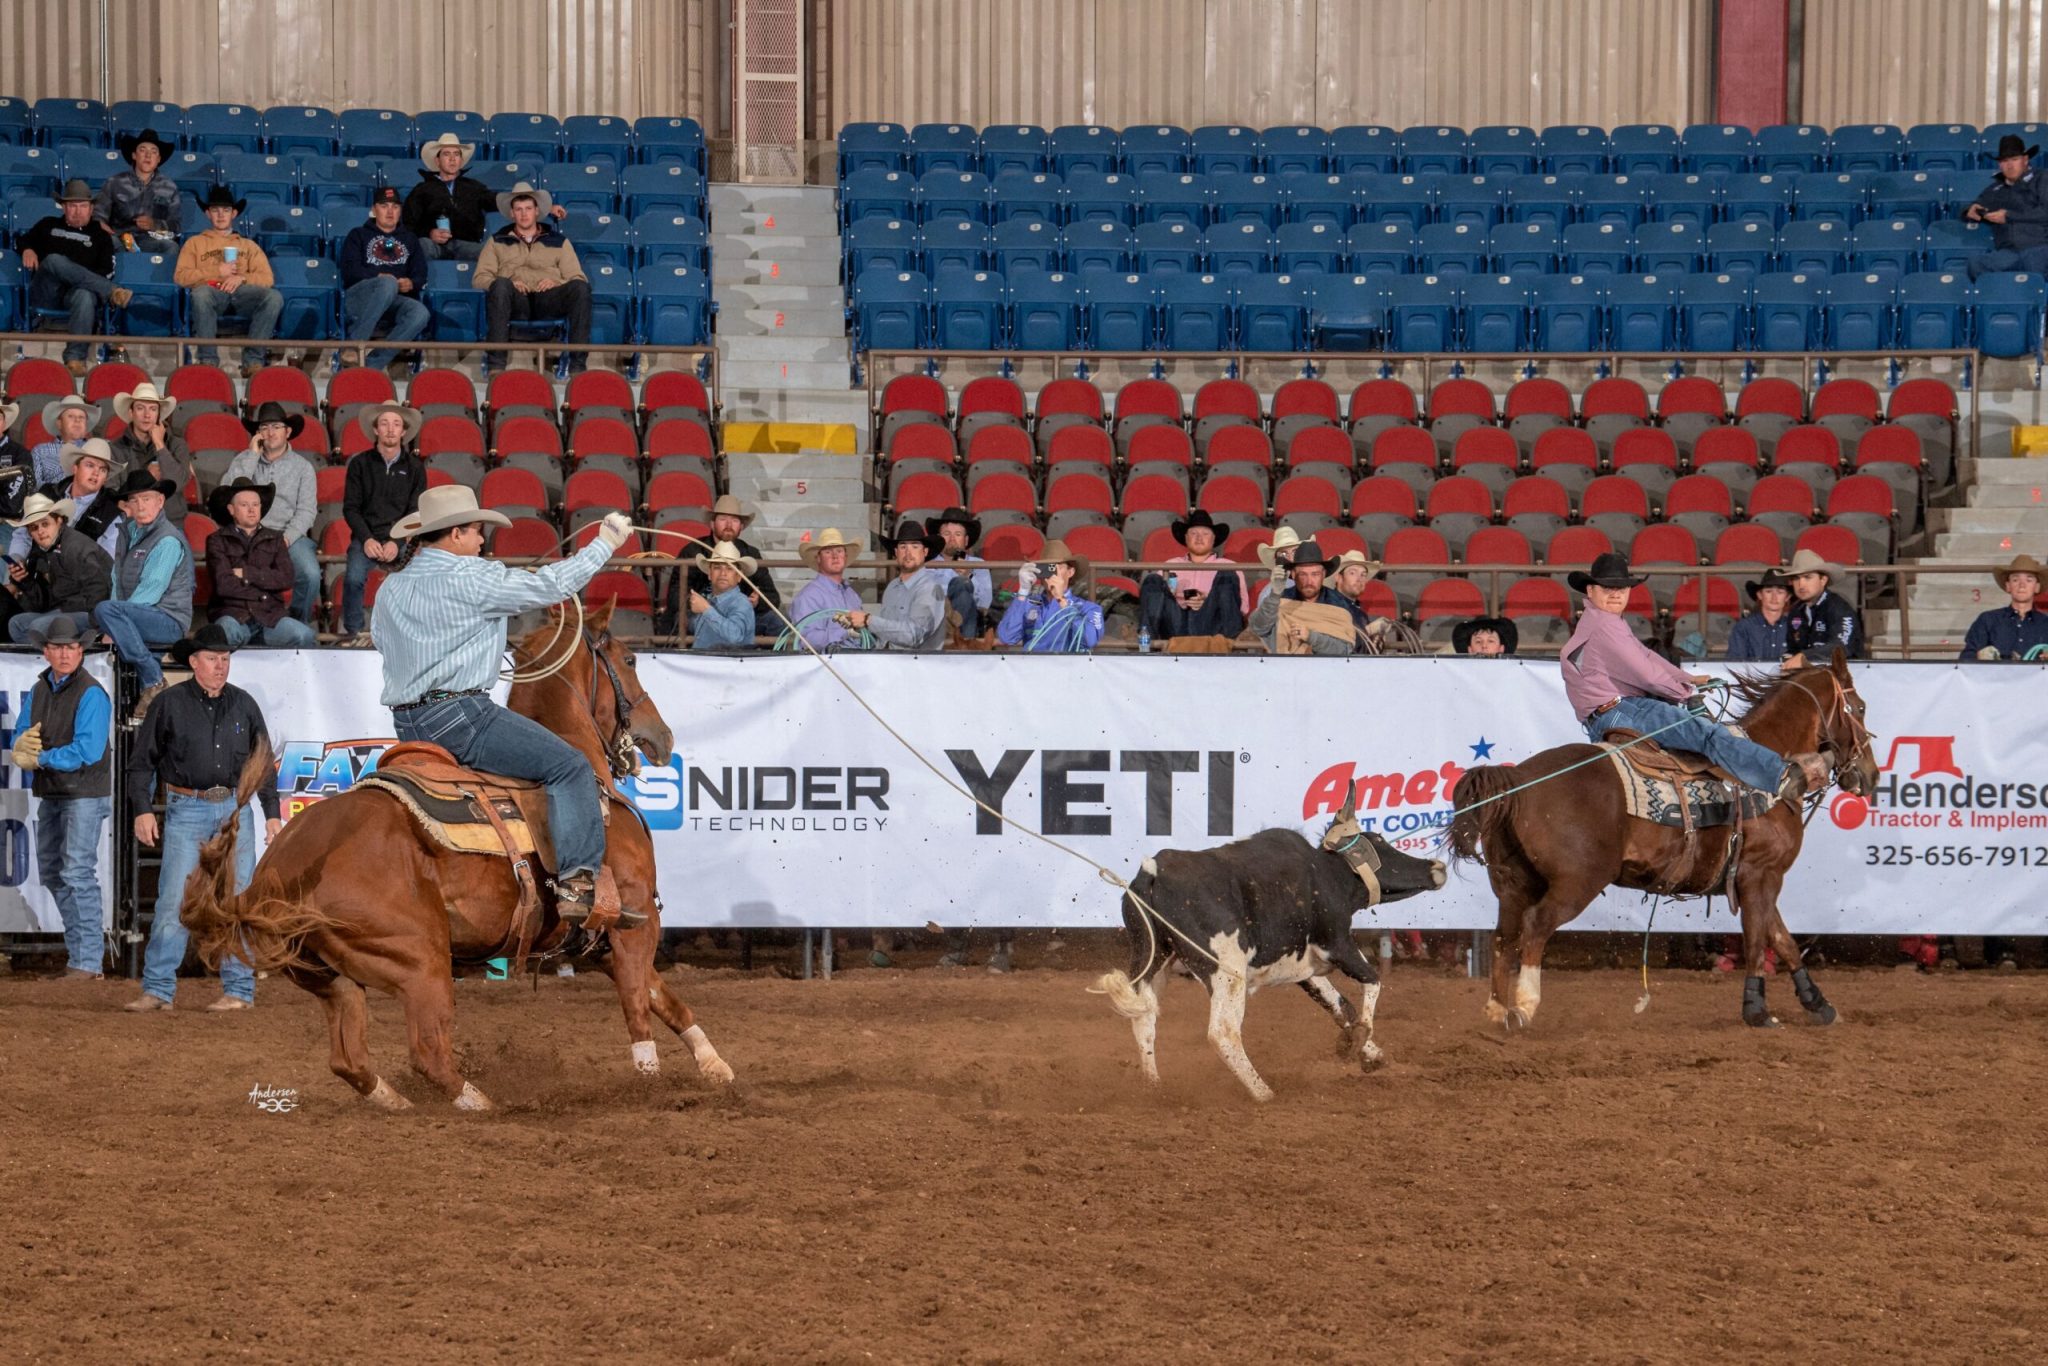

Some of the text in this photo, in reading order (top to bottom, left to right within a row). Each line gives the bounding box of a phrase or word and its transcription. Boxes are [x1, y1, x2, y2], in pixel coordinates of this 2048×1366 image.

[764, 216, 776, 230] 4
[770, 263, 780, 278] 3
[775, 312, 785, 328] 2
[782, 364, 788, 378] 1
[797, 482, 807, 495] 5
[1971, 589, 1981, 603] 3
[634, 766, 890, 811] SNIDER
[1303, 760, 1465, 821] Amer
[690, 817, 888, 832] TECHNOLOGY
[1868, 809, 2048, 832] Tractor & Implem
[1395, 837, 1428, 851] 1915
[1866, 845, 2048, 867] 325-656-7912
